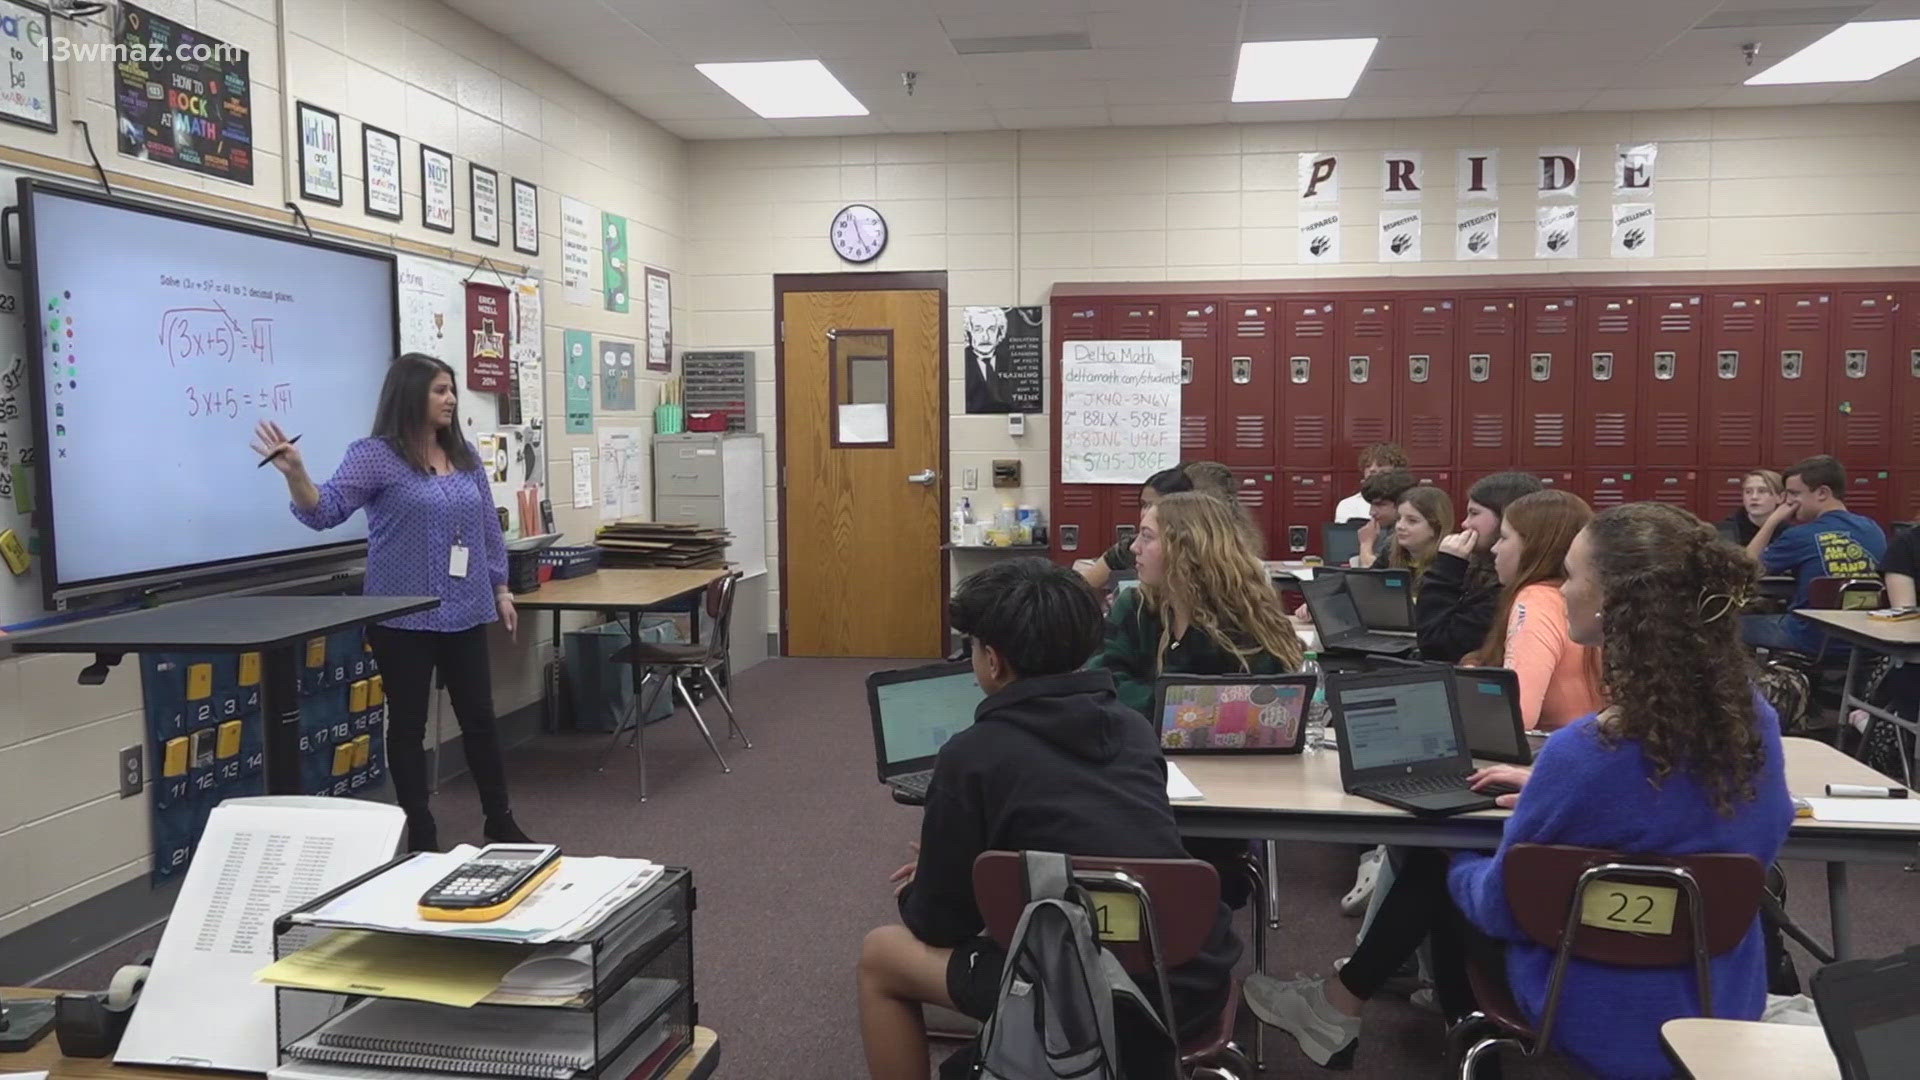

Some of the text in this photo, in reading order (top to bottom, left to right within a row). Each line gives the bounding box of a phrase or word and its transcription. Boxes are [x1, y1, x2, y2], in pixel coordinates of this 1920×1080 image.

[11, 46, 23, 60] to
[9, 61, 25, 88] be
[172, 73, 204, 95] HOW TO
[168, 89, 208, 118] ROCK
[161, 113, 172, 127] AT
[175, 112, 216, 140] MATH
[427, 162, 448, 184] NOT
[1458, 211, 1497, 232] INTEGRITY
[1074, 344, 1156, 363] Delta Math
[1829, 560, 1867, 573] BAND
[335, 667, 344, 680] 8
[355, 661, 363, 675] 9
[174, 692, 258, 727] 1 2 3 4
[315, 728, 328, 744] 17
[332, 723, 348, 737] 18
[171, 752, 263, 798] 11 12 13 14
[172, 846, 190, 866] 21
[1606, 892, 1654, 925] 22
